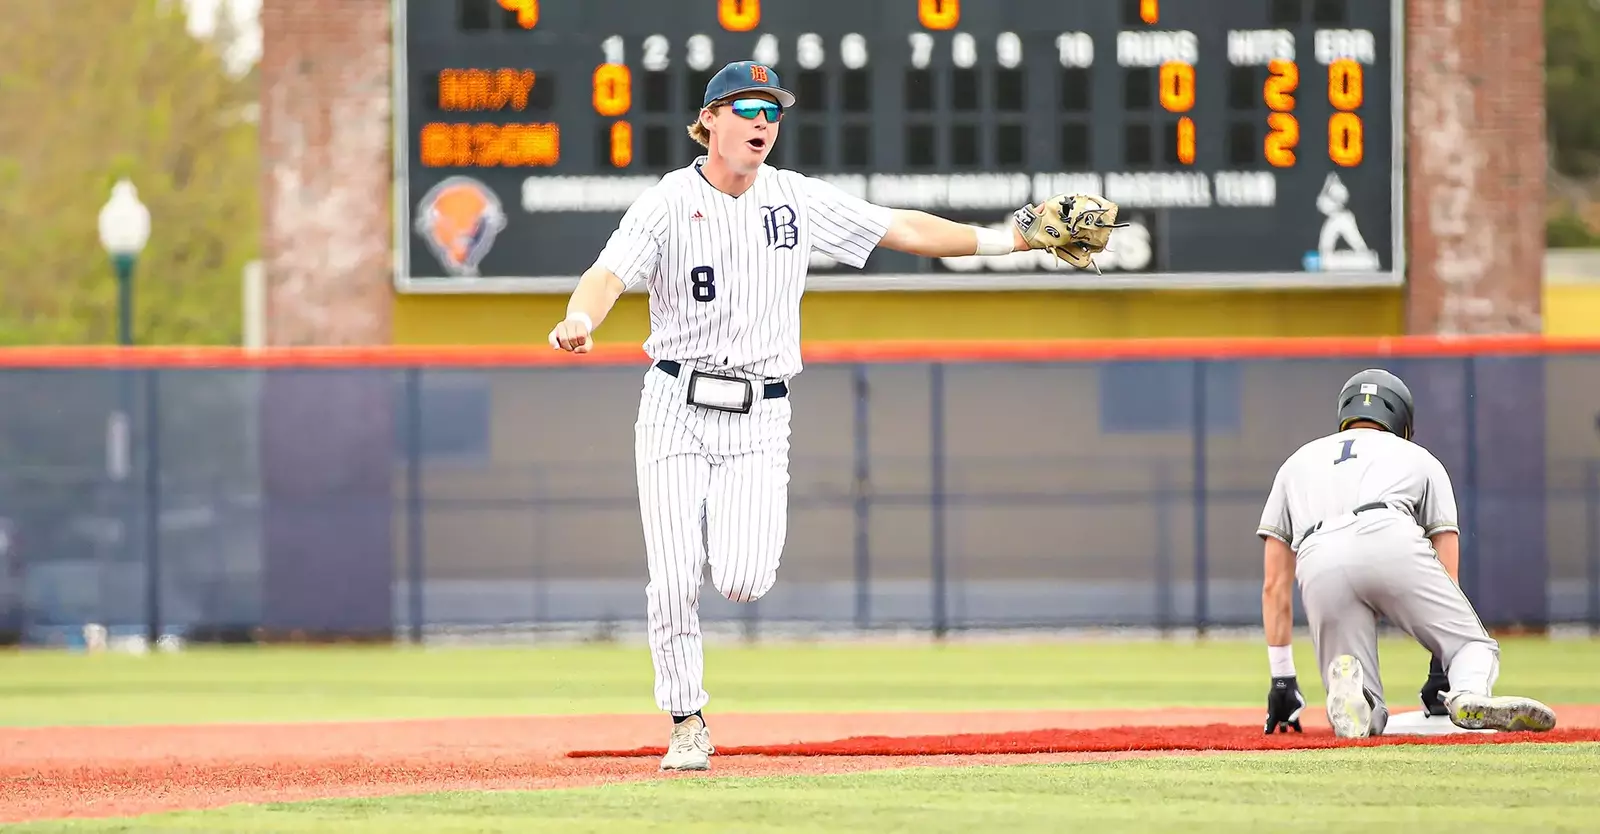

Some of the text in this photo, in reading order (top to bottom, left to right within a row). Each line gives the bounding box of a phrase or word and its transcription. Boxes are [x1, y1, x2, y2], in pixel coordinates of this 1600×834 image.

[602, 35, 624, 64] 1
[642, 34, 670, 71] 2
[686, 34, 714, 71] 3
[753, 33, 779, 68] 4
[841, 33, 867, 70] 6
[908, 32, 934, 69] 7
[952, 32, 977, 68] 8
[996, 32, 1023, 68] 9
[1056, 31, 1095, 69] 10
[1117, 30, 1199, 67] RUNS
[1227, 29, 1296, 66] HITS
[592, 63, 632, 117] 0
[1159, 60, 1196, 112] 0
[1263, 59, 1299, 112] 2
[1328, 57, 1363, 111] 0
[750, 64, 768, 84] B
[610, 120, 632, 168] 1
[1177, 116, 1196, 164] 1
[1263, 112, 1299, 168] 2
[1328, 111, 1363, 167] 0
[760, 204, 798, 251] B
[690, 265, 716, 303] 8
[1333, 438, 1358, 465] 1
